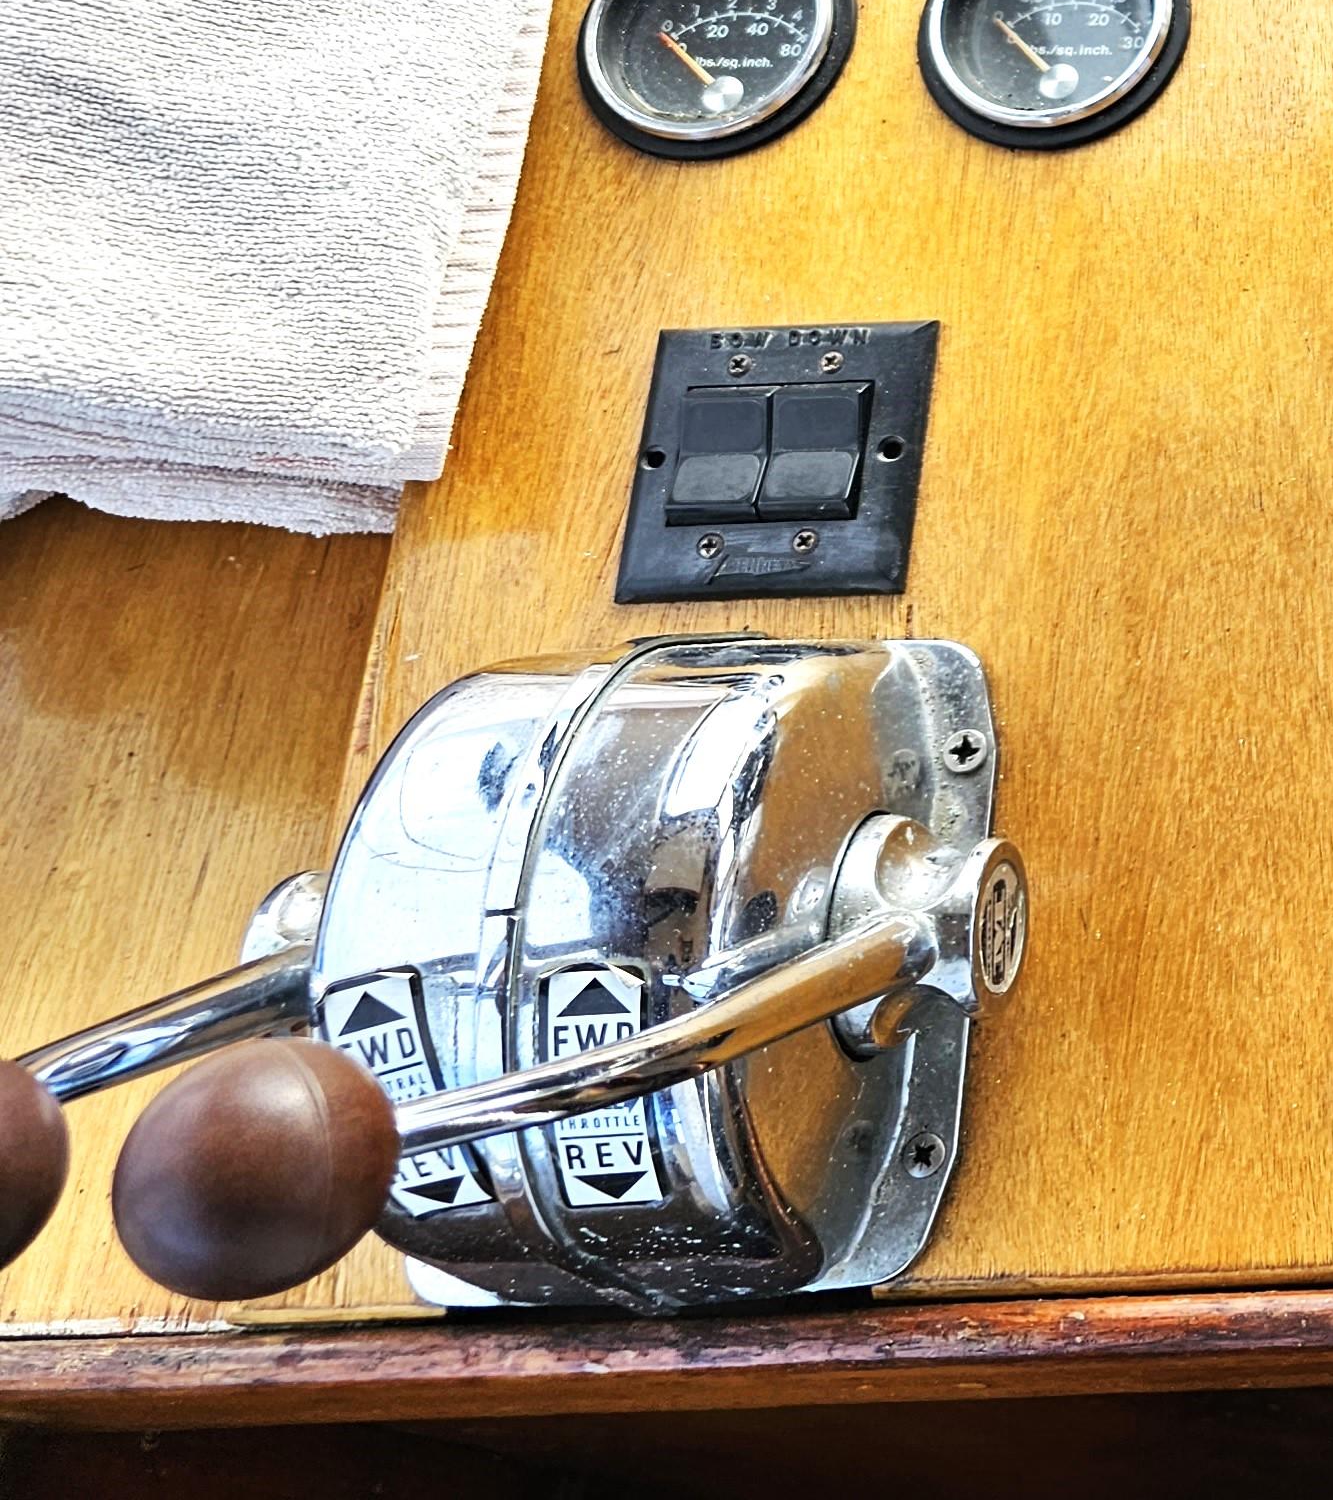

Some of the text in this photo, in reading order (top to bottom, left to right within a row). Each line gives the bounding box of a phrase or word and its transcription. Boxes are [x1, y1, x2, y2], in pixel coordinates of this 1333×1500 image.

[1044, 13, 1062, 27] 10
[1088, 13, 1110, 27] 20
[706, 25, 729, 40] 20
[747, 21, 768, 36] 40
[780, 43, 802, 57] 80
[1121, 35, 1144, 50] 30
[710, 328, 871, 350] BOW DOWN
[560, 1114, 641, 1130] THROTTLE
[565, 1140, 643, 1171] REV
